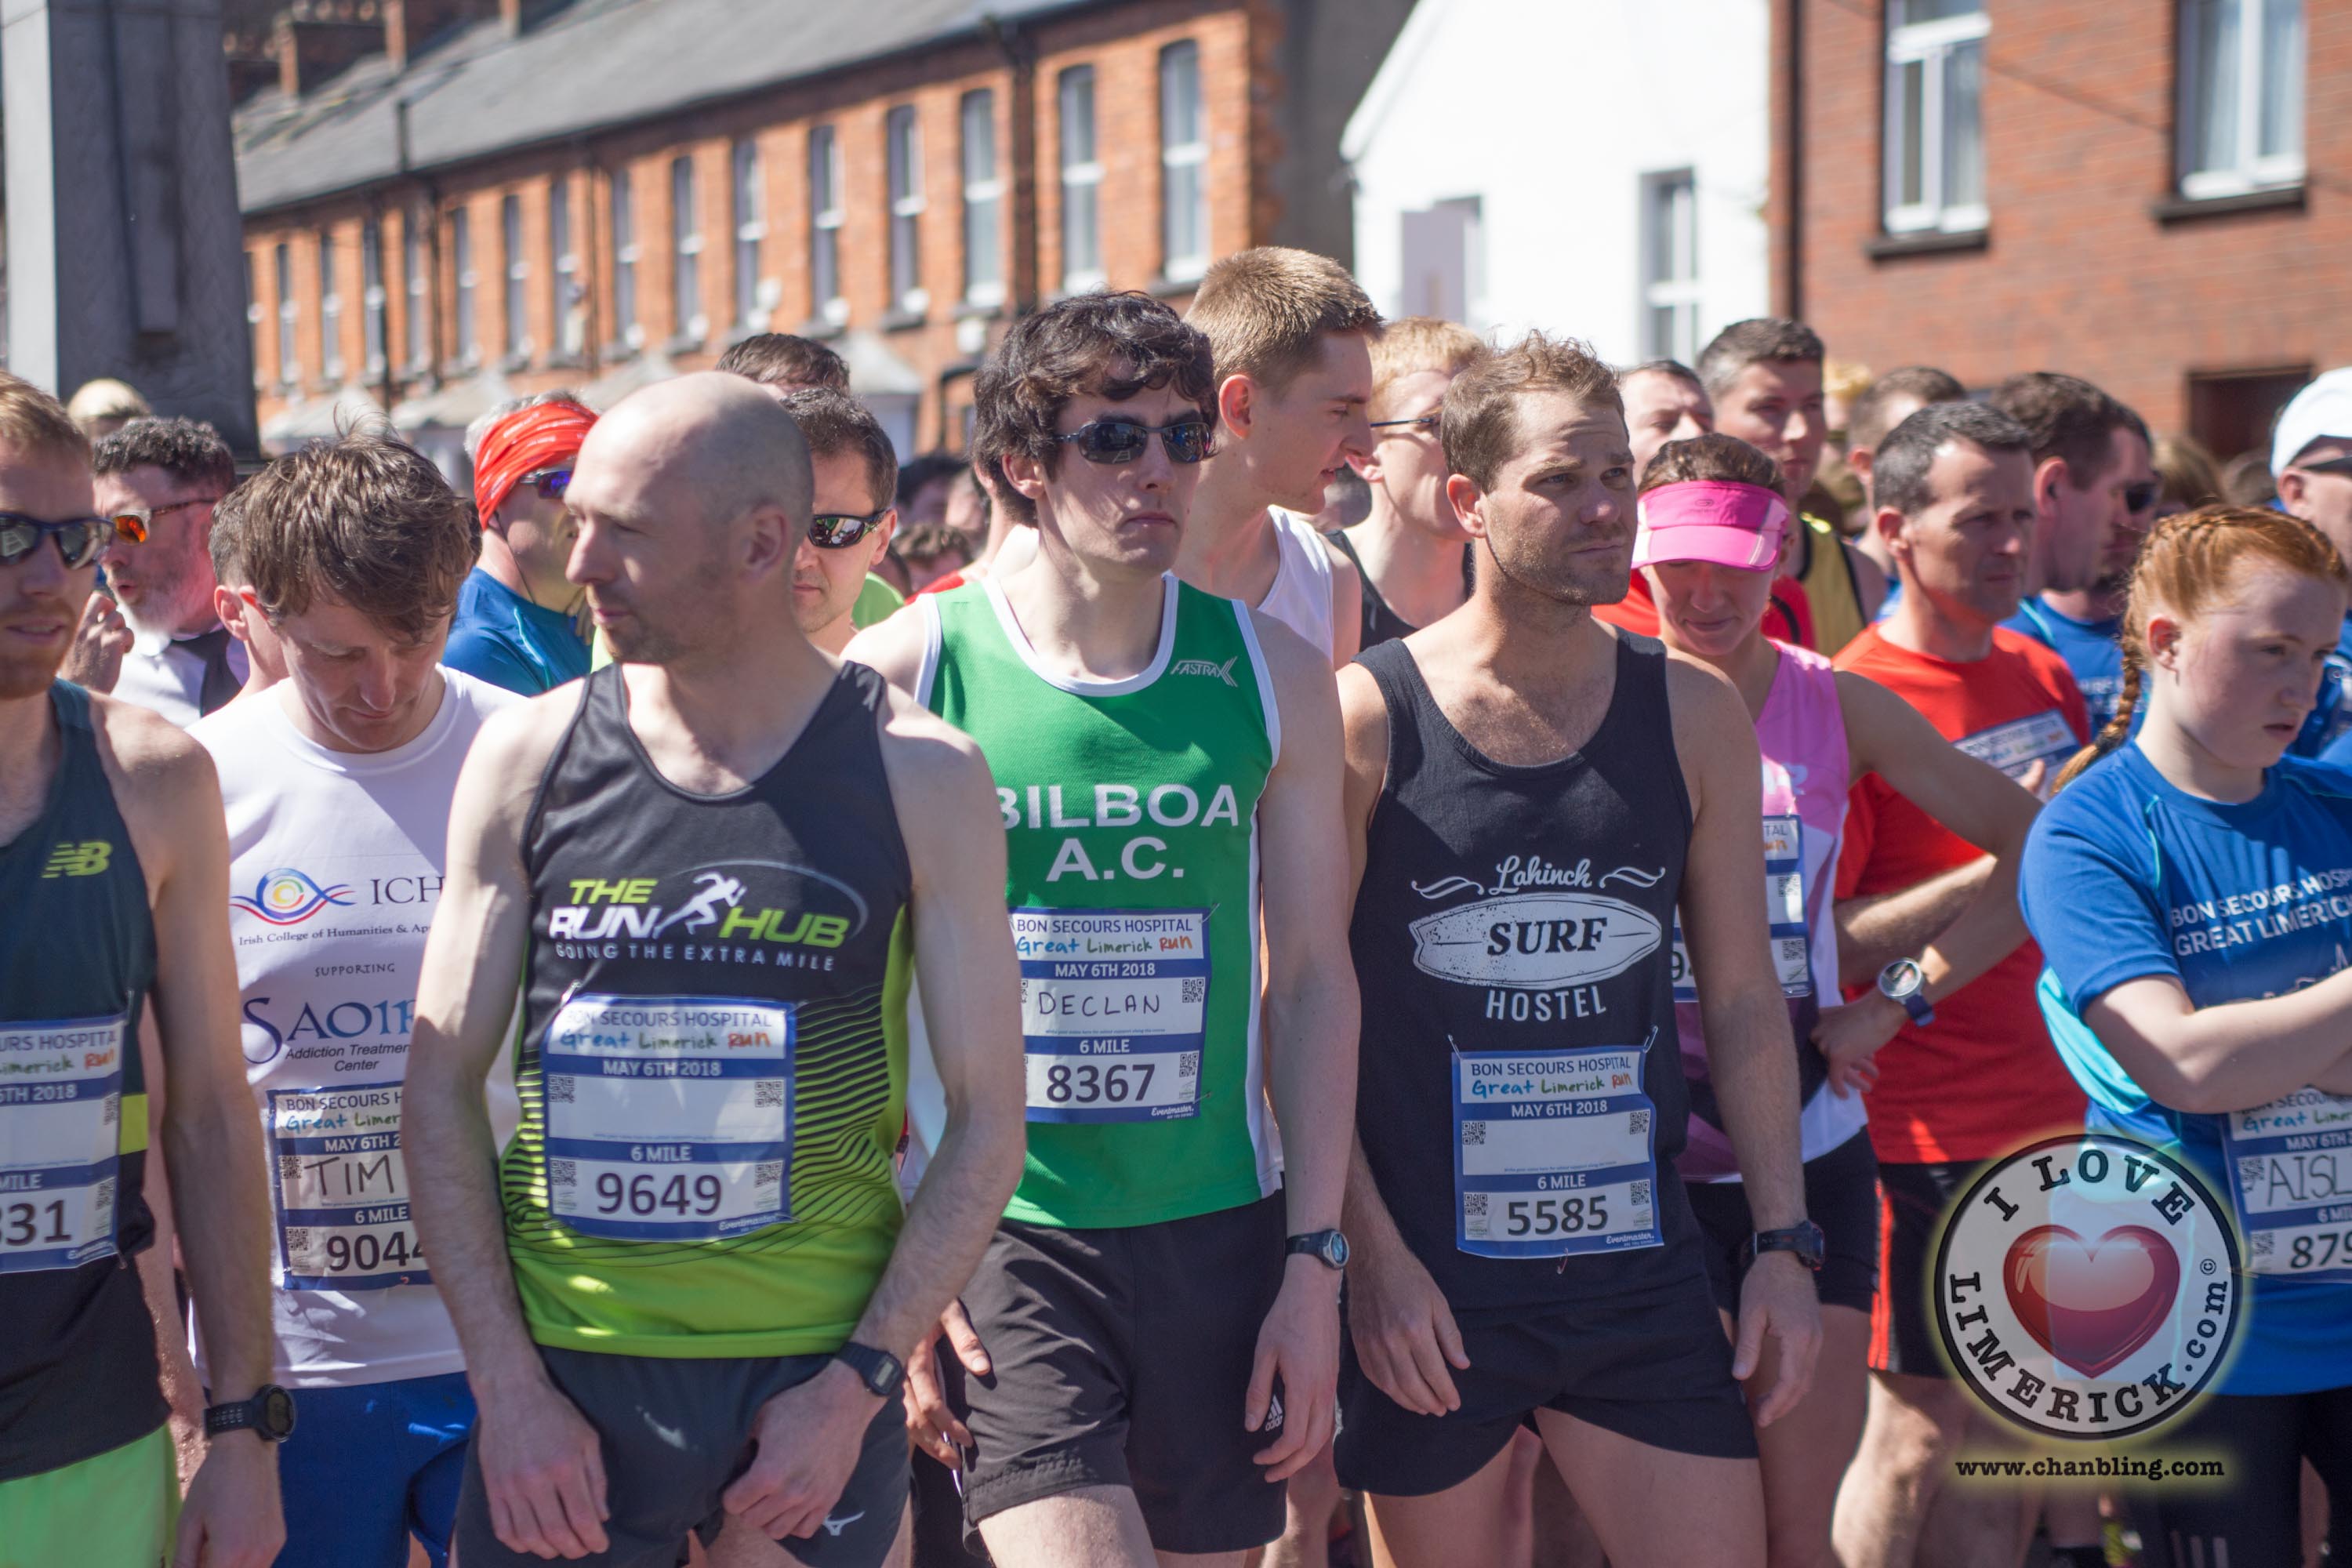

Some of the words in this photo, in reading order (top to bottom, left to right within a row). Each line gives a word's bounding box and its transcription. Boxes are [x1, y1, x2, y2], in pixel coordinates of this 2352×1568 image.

[996, 783, 1240, 829] BILBOA
[1045, 836, 1185, 882] A.C.
[1488, 855, 1592, 895] Lahinch
[569, 877, 659, 906] THE
[2170, 902, 2216, 928] BON
[2217, 880, 2303, 918] SECOURS
[238, 935, 263, 946] Irish
[267, 930, 309, 943] College
[312, 929, 325, 940] of
[327, 924, 394, 938] Humanities
[395, 924, 408, 934] &
[548, 906, 664, 940] RUN
[719, 906, 851, 949] HUB
[1017, 919, 1048, 933] BON
[1052, 919, 1121, 934] SECOURS
[1124, 918, 1194, 933] HOSPITAL
[1486, 916, 1607, 956] SURF
[2175, 920, 2253, 957] GREAT
[2256, 895, 2352, 939] LIMERIC
[1016, 935, 1080, 956] Great
[1087, 937, 1153, 954] Limerick
[1159, 935, 1193, 953] Run
[555, 942, 619, 960] GOING
[629, 943, 675, 960] THE
[684, 946, 767, 966] EXTRA
[775, 950, 836, 972] MILE
[314, 963, 396, 978] SUPPORTING
[1054, 963, 1089, 978] MAY
[1091, 963, 1119, 978] 6TH
[1122, 962, 1156, 977] 2018
[1037, 991, 1160, 1018] DECLAN
[1486, 985, 1606, 1022] HOSTEL
[601, 1011, 679, 1028] SECOURS
[684, 1011, 773, 1028] HOSPITAL
[560, 1029, 631, 1050] Great
[638, 1032, 717, 1051] Limerick
[727, 1031, 771, 1049] Run
[1079, 1040, 1090, 1054] 6
[1093, 1038, 1131, 1054] MILE
[285, 1046, 345, 1060] Addiction
[334, 1059, 379, 1073] Center
[603, 1060, 641, 1076] MAY
[643, 1060, 677, 1077] 6TH
[681, 1061, 722, 1076] 2018
[1471, 1063, 1503, 1076] BON
[1507, 1061, 1574, 1076] SECOURS
[1579, 1056, 1631, 1073] HOSPITAL
[32, 1083, 78, 1102] 2018
[1046, 1063, 1156, 1103] 8367
[1472, 1080, 1534, 1098] Great
[1540, 1075, 1605, 1094] Limerick
[1611, 1074, 1632, 1089] Run
[286, 1098, 315, 1112] BON
[319, 1092, 390, 1110] SECOURS
[1511, 1103, 1543, 1119] MAY
[1545, 1102, 1573, 1117] 6TH
[1576, 1099, 1608, 1115] 2018
[285, 1113, 348, 1134] Great
[2242, 1110, 2308, 1134] Great
[325, 1138, 357, 1152] MAY
[361, 1136, 390, 1150] 6TH
[2285, 1134, 2318, 1151] MAY
[2320, 1131, 2347, 1148] 6TH
[630, 1147, 641, 1162] 6
[647, 1145, 691, 1162] MILE
[303, 1154, 395, 1196] TIM
[1537, 1176, 1546, 1190] 6
[1551, 1174, 1587, 1189] MILE
[2267, 1154, 2352, 1207] AISL
[596, 1172, 723, 1217] 9649
[0, 1200, 72, 1247] 31
[354, 1210, 365, 1225] 6
[368, 1207, 408, 1224] MILE
[1507, 1195, 1609, 1236] 5585
[2318, 1208, 2328, 1224] 6
